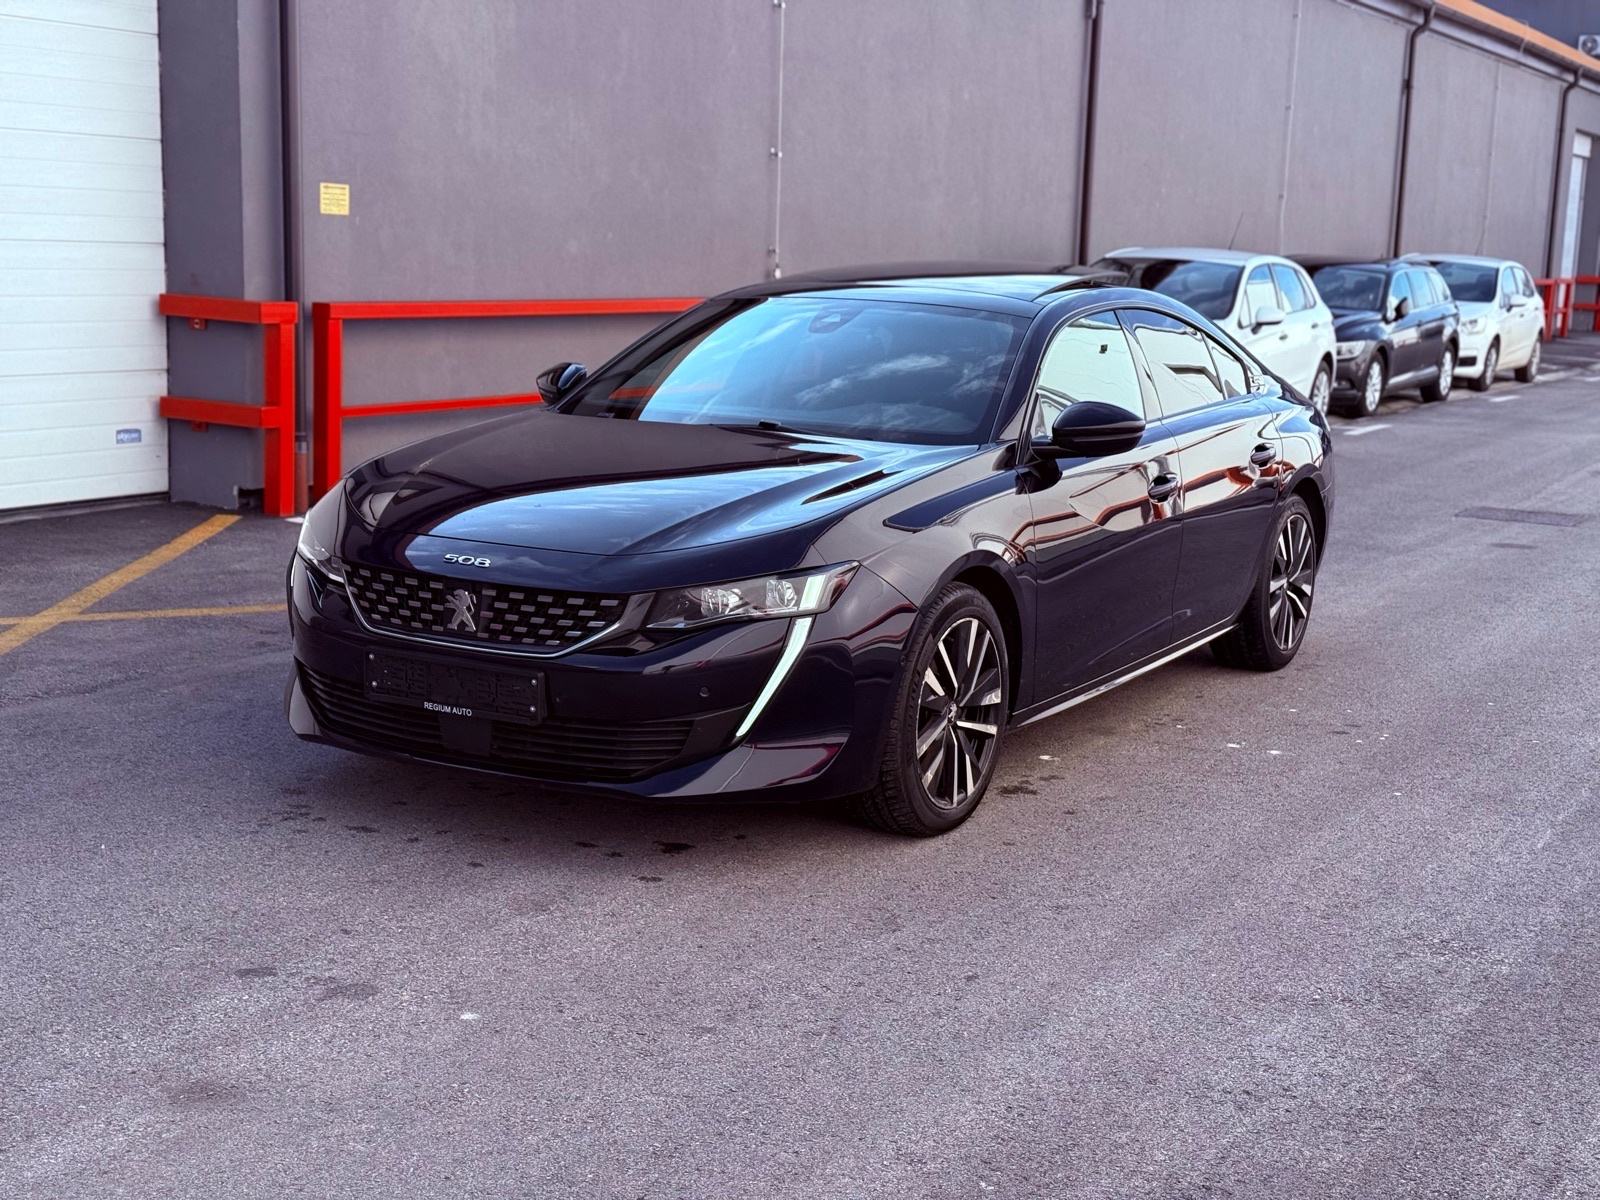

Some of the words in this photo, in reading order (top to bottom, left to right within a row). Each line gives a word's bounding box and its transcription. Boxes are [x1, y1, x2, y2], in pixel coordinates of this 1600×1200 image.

[443, 554, 491, 568] 508
[424, 701, 451, 713] REGIUM
[452, 706, 473, 717] AUTO
